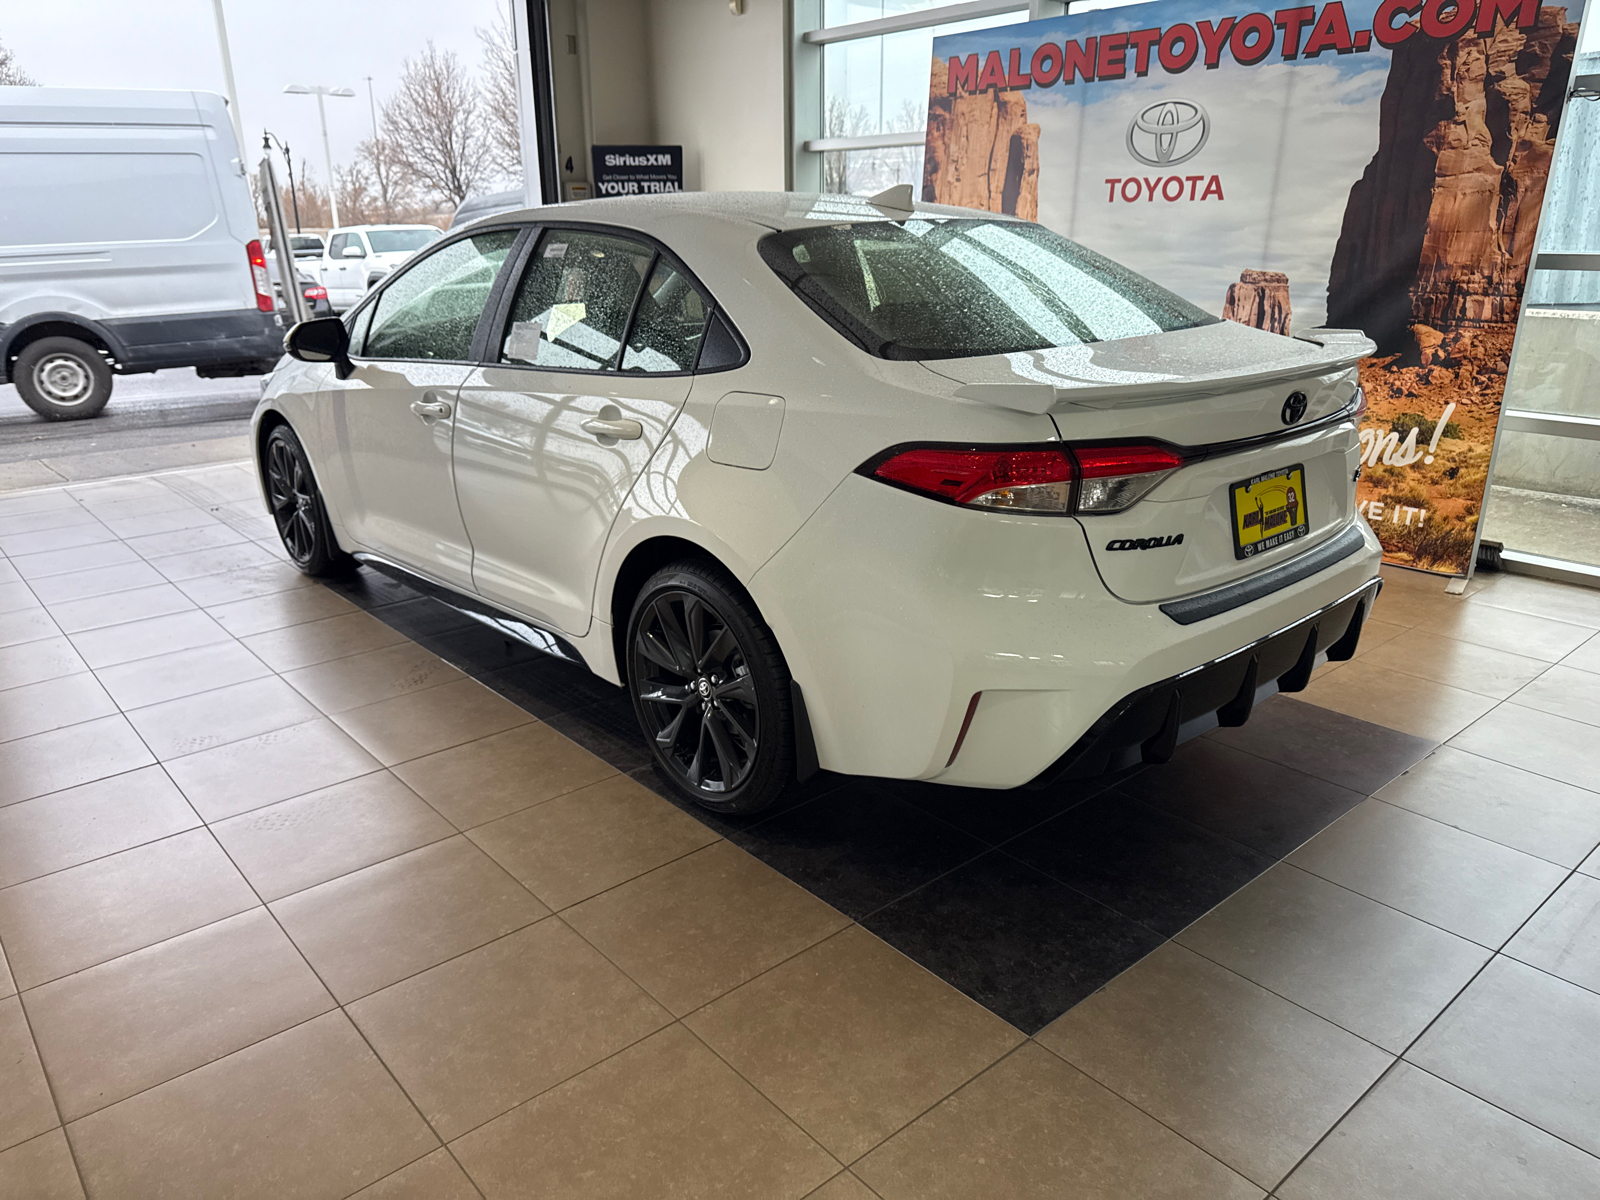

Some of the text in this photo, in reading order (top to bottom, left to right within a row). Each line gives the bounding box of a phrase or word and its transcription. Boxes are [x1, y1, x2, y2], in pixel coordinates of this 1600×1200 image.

[947, 0, 1542, 96] MALONETOYOTA.COM
[565, 156, 574, 174] 4
[605, 154, 671, 166] SiriusXM
[598, 182, 639, 194] YOUR
[641, 181, 682, 193] TRIAL
[1105, 175, 1224, 202] TOYOTA
[1287, 492, 1295, 503] 32
[1393, 505, 1426, 528] IT!
[1105, 533, 1184, 551] COROLLA
[1257, 530, 1295, 551] WE MAKE IT EASY
